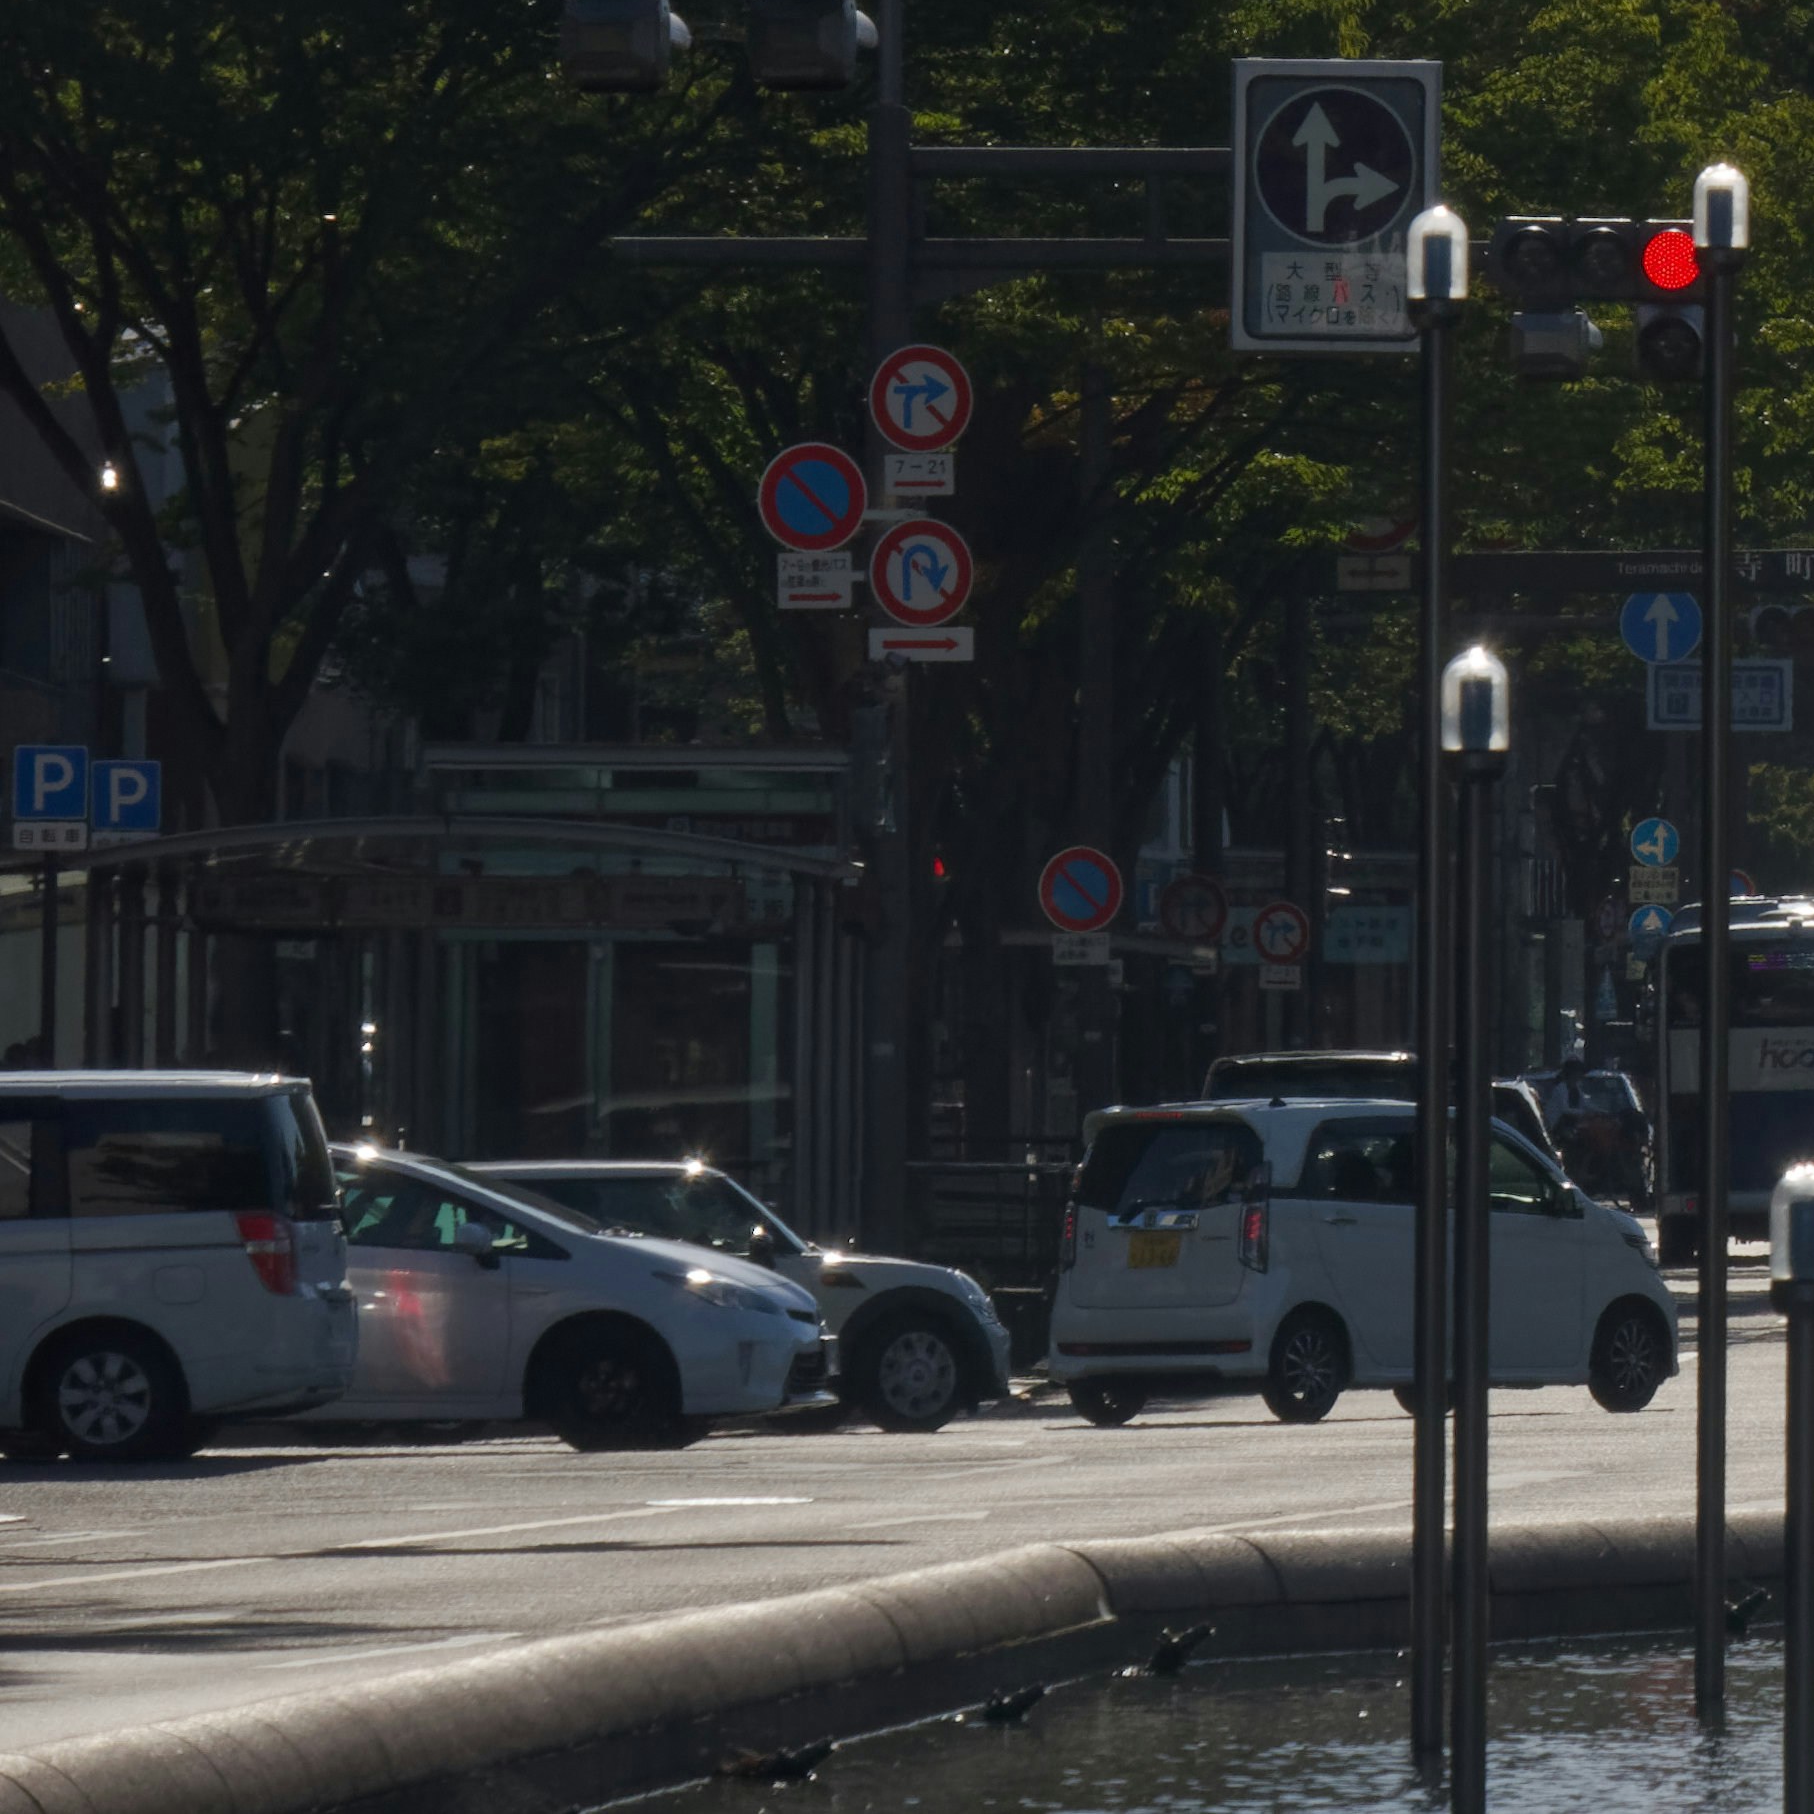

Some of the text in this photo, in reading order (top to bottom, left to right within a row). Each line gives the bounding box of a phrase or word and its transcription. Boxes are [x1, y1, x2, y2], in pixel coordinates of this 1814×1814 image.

[34, 753, 75, 811] P
[108, 767, 149, 823] P
[19, 828, 81, 844] 自転車
